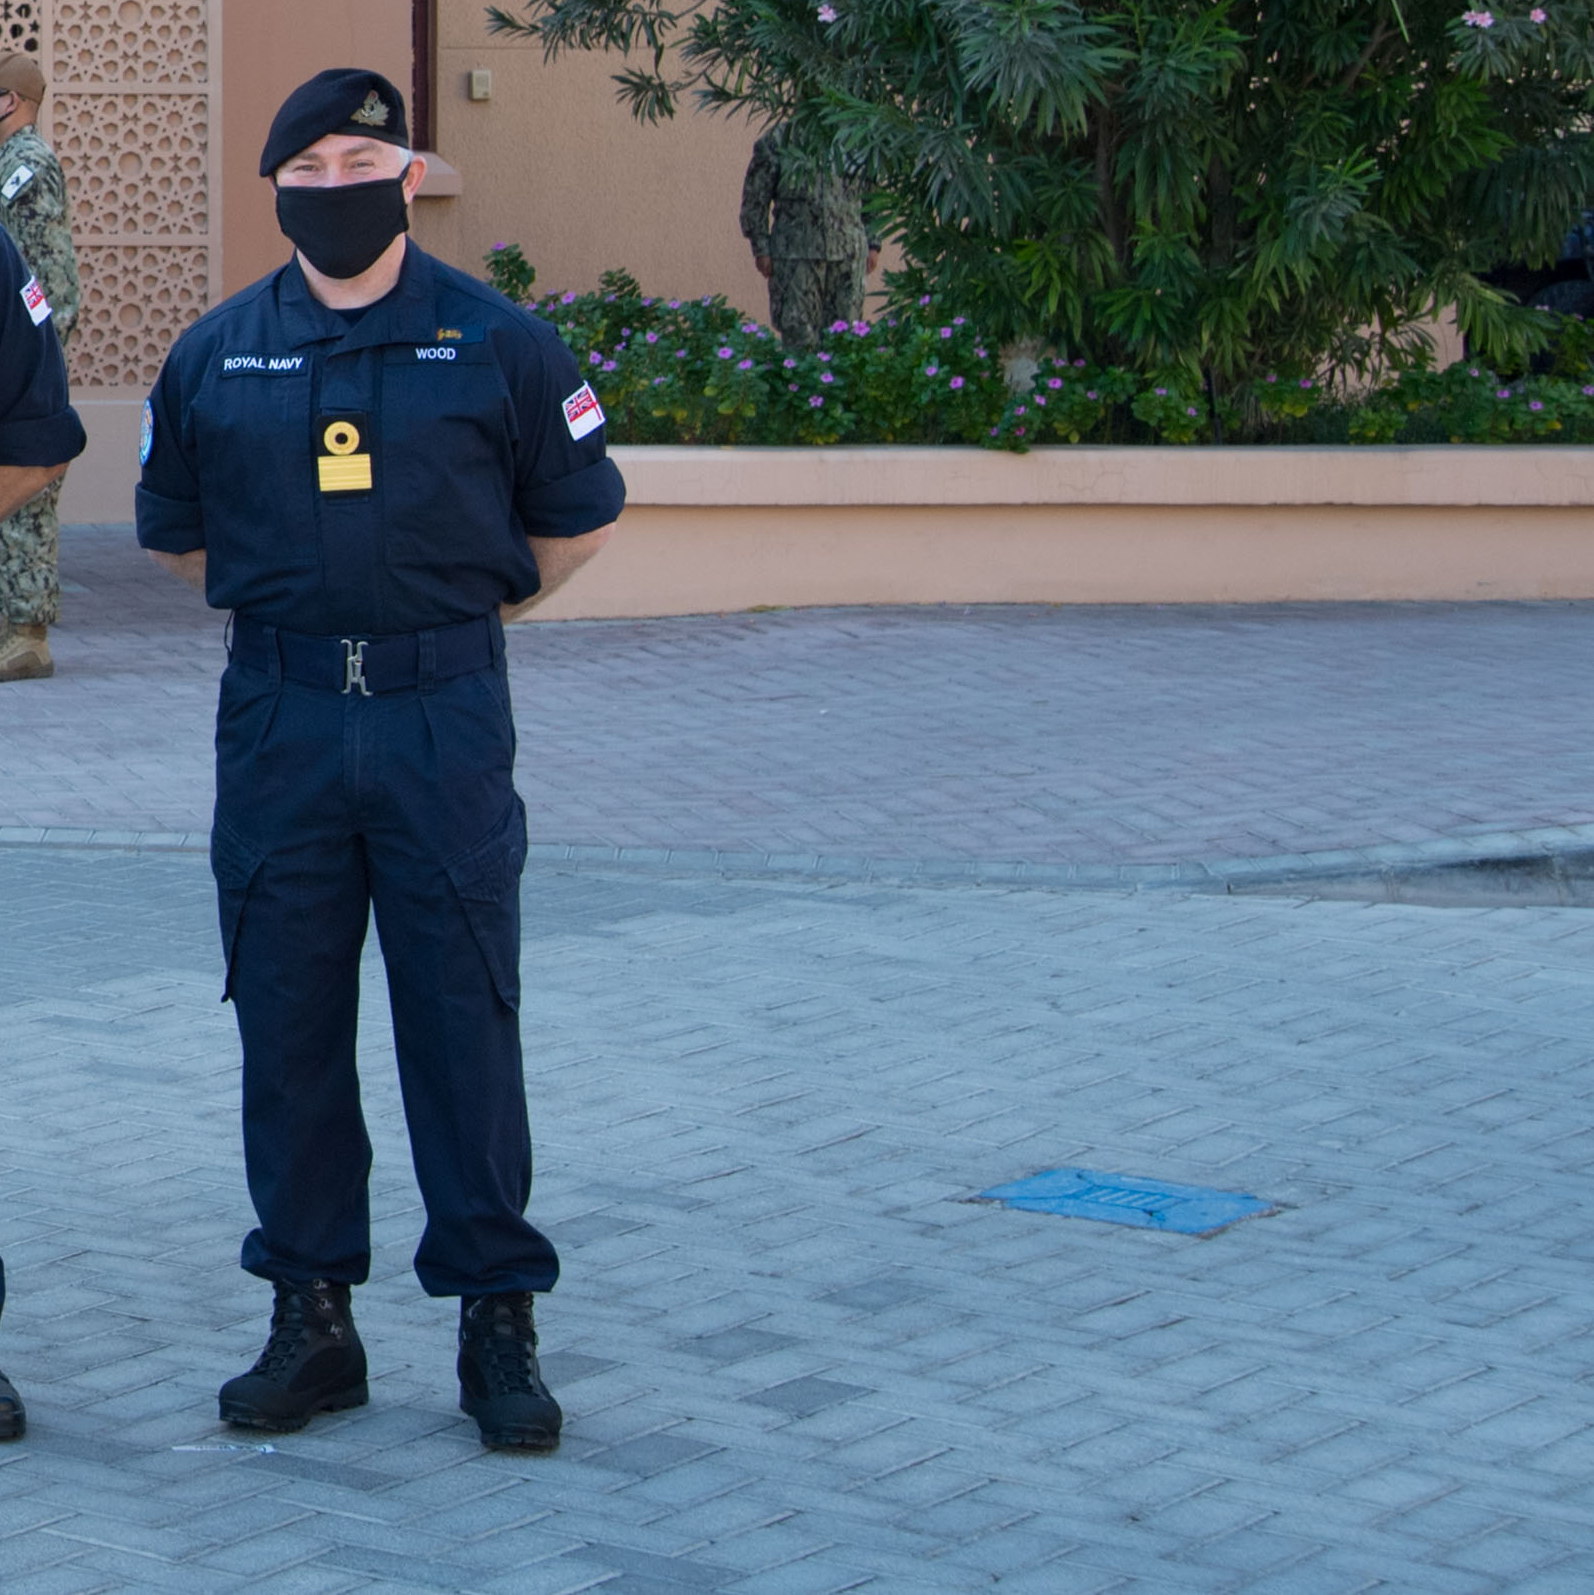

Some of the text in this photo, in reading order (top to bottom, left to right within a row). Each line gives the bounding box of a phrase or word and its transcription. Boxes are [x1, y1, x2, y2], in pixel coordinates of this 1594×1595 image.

[415, 347, 456, 361] WOOD
[223, 357, 303, 371] ROYAL NAVY
